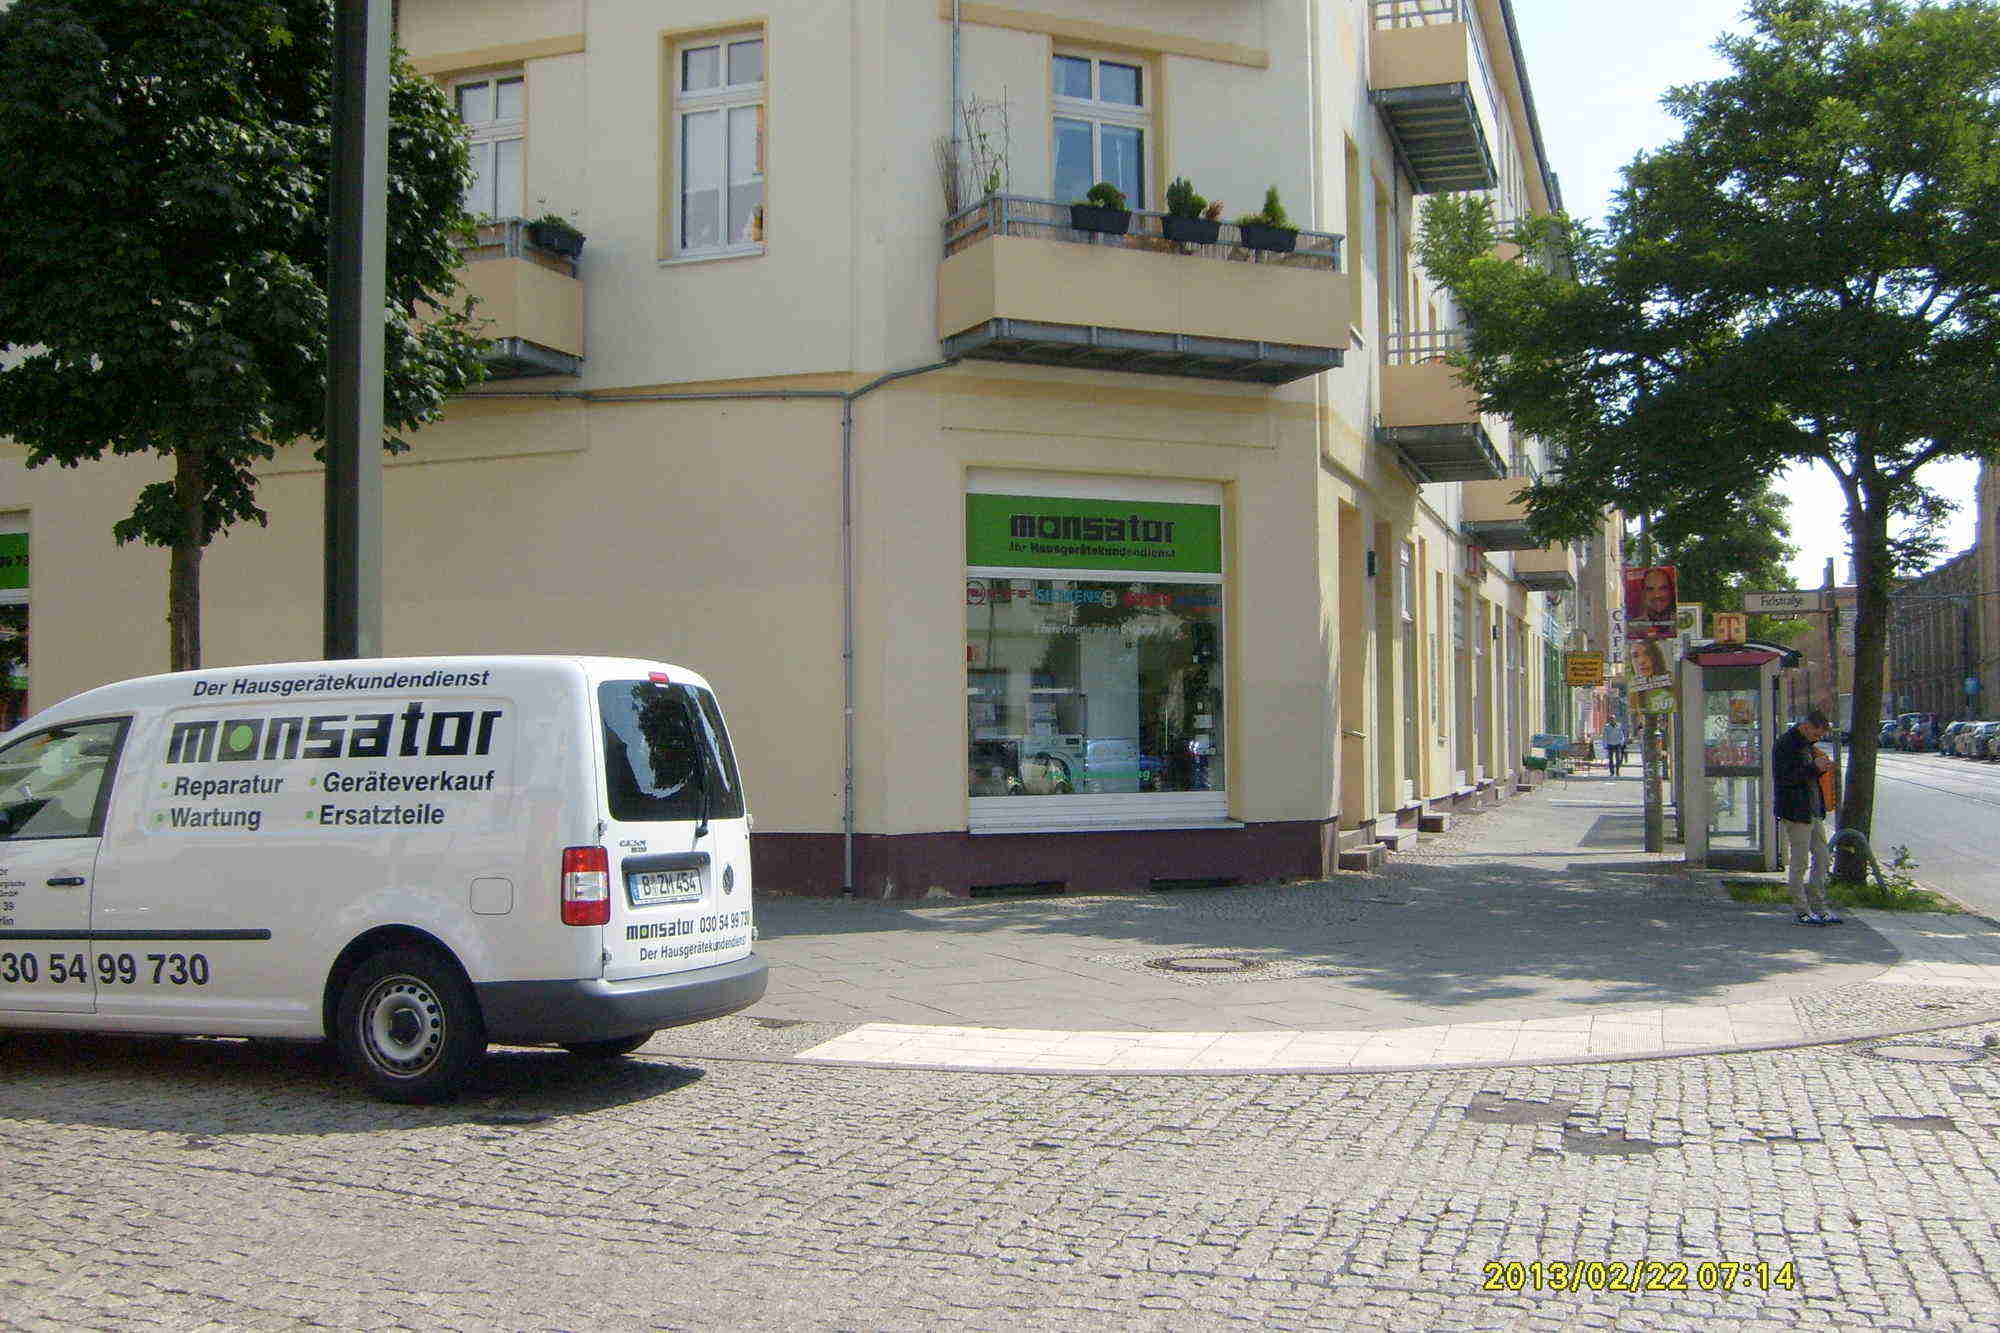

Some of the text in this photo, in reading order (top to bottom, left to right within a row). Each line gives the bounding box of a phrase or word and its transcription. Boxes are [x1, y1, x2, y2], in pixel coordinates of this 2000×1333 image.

[1010, 515, 1176, 543] monsator
[1009, 542, 1025, 553] Ihr
[193, 670, 491, 697] Der Hausgerätekundendienst
[166, 702, 502, 764] monsator
[173, 770, 495, 800] Reparatur Geräteverkauf
[170, 803, 445, 831] Wartung Ersatzteile
[642, 876, 651, 895] B
[677, 870, 697, 893] 454
[626, 918, 695, 940] monsator
[700, 917, 716, 933] 030
[719, 914, 729, 930] 54
[640, 947, 659, 961] Der
[50, 953, 88, 984] 54
[99, 953, 137, 985] 99
[146, 953, 210, 985] 730
